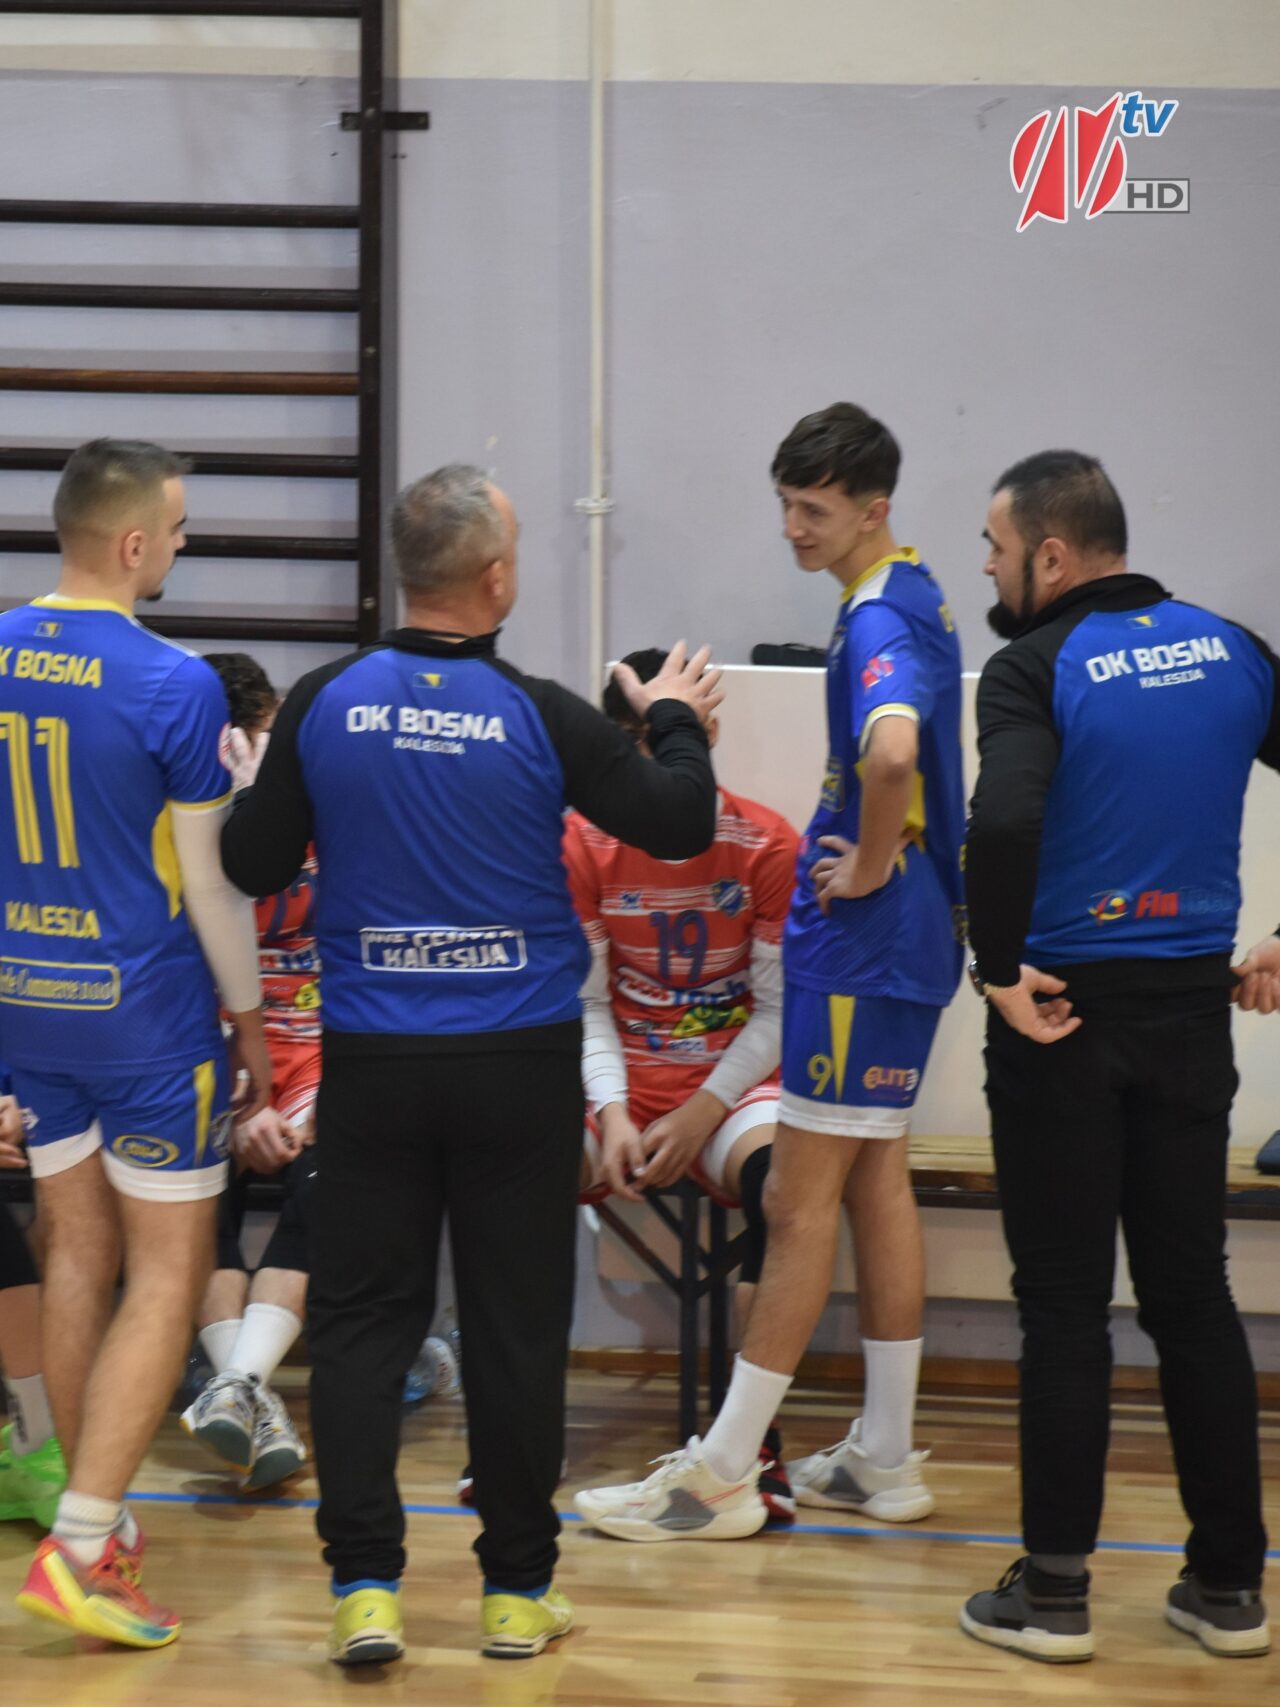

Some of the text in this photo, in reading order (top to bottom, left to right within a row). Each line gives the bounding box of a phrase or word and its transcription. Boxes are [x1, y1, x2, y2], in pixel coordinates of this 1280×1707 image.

[13, 649, 102, 689] BOSNA
[1085, 636, 1231, 683] OK BOSNA
[346, 705, 507, 743] OK BOSNA
[382, 943, 510, 968] KALESIJA
[649, 910, 708, 982] 19
[807, 1053, 834, 1096] 9
